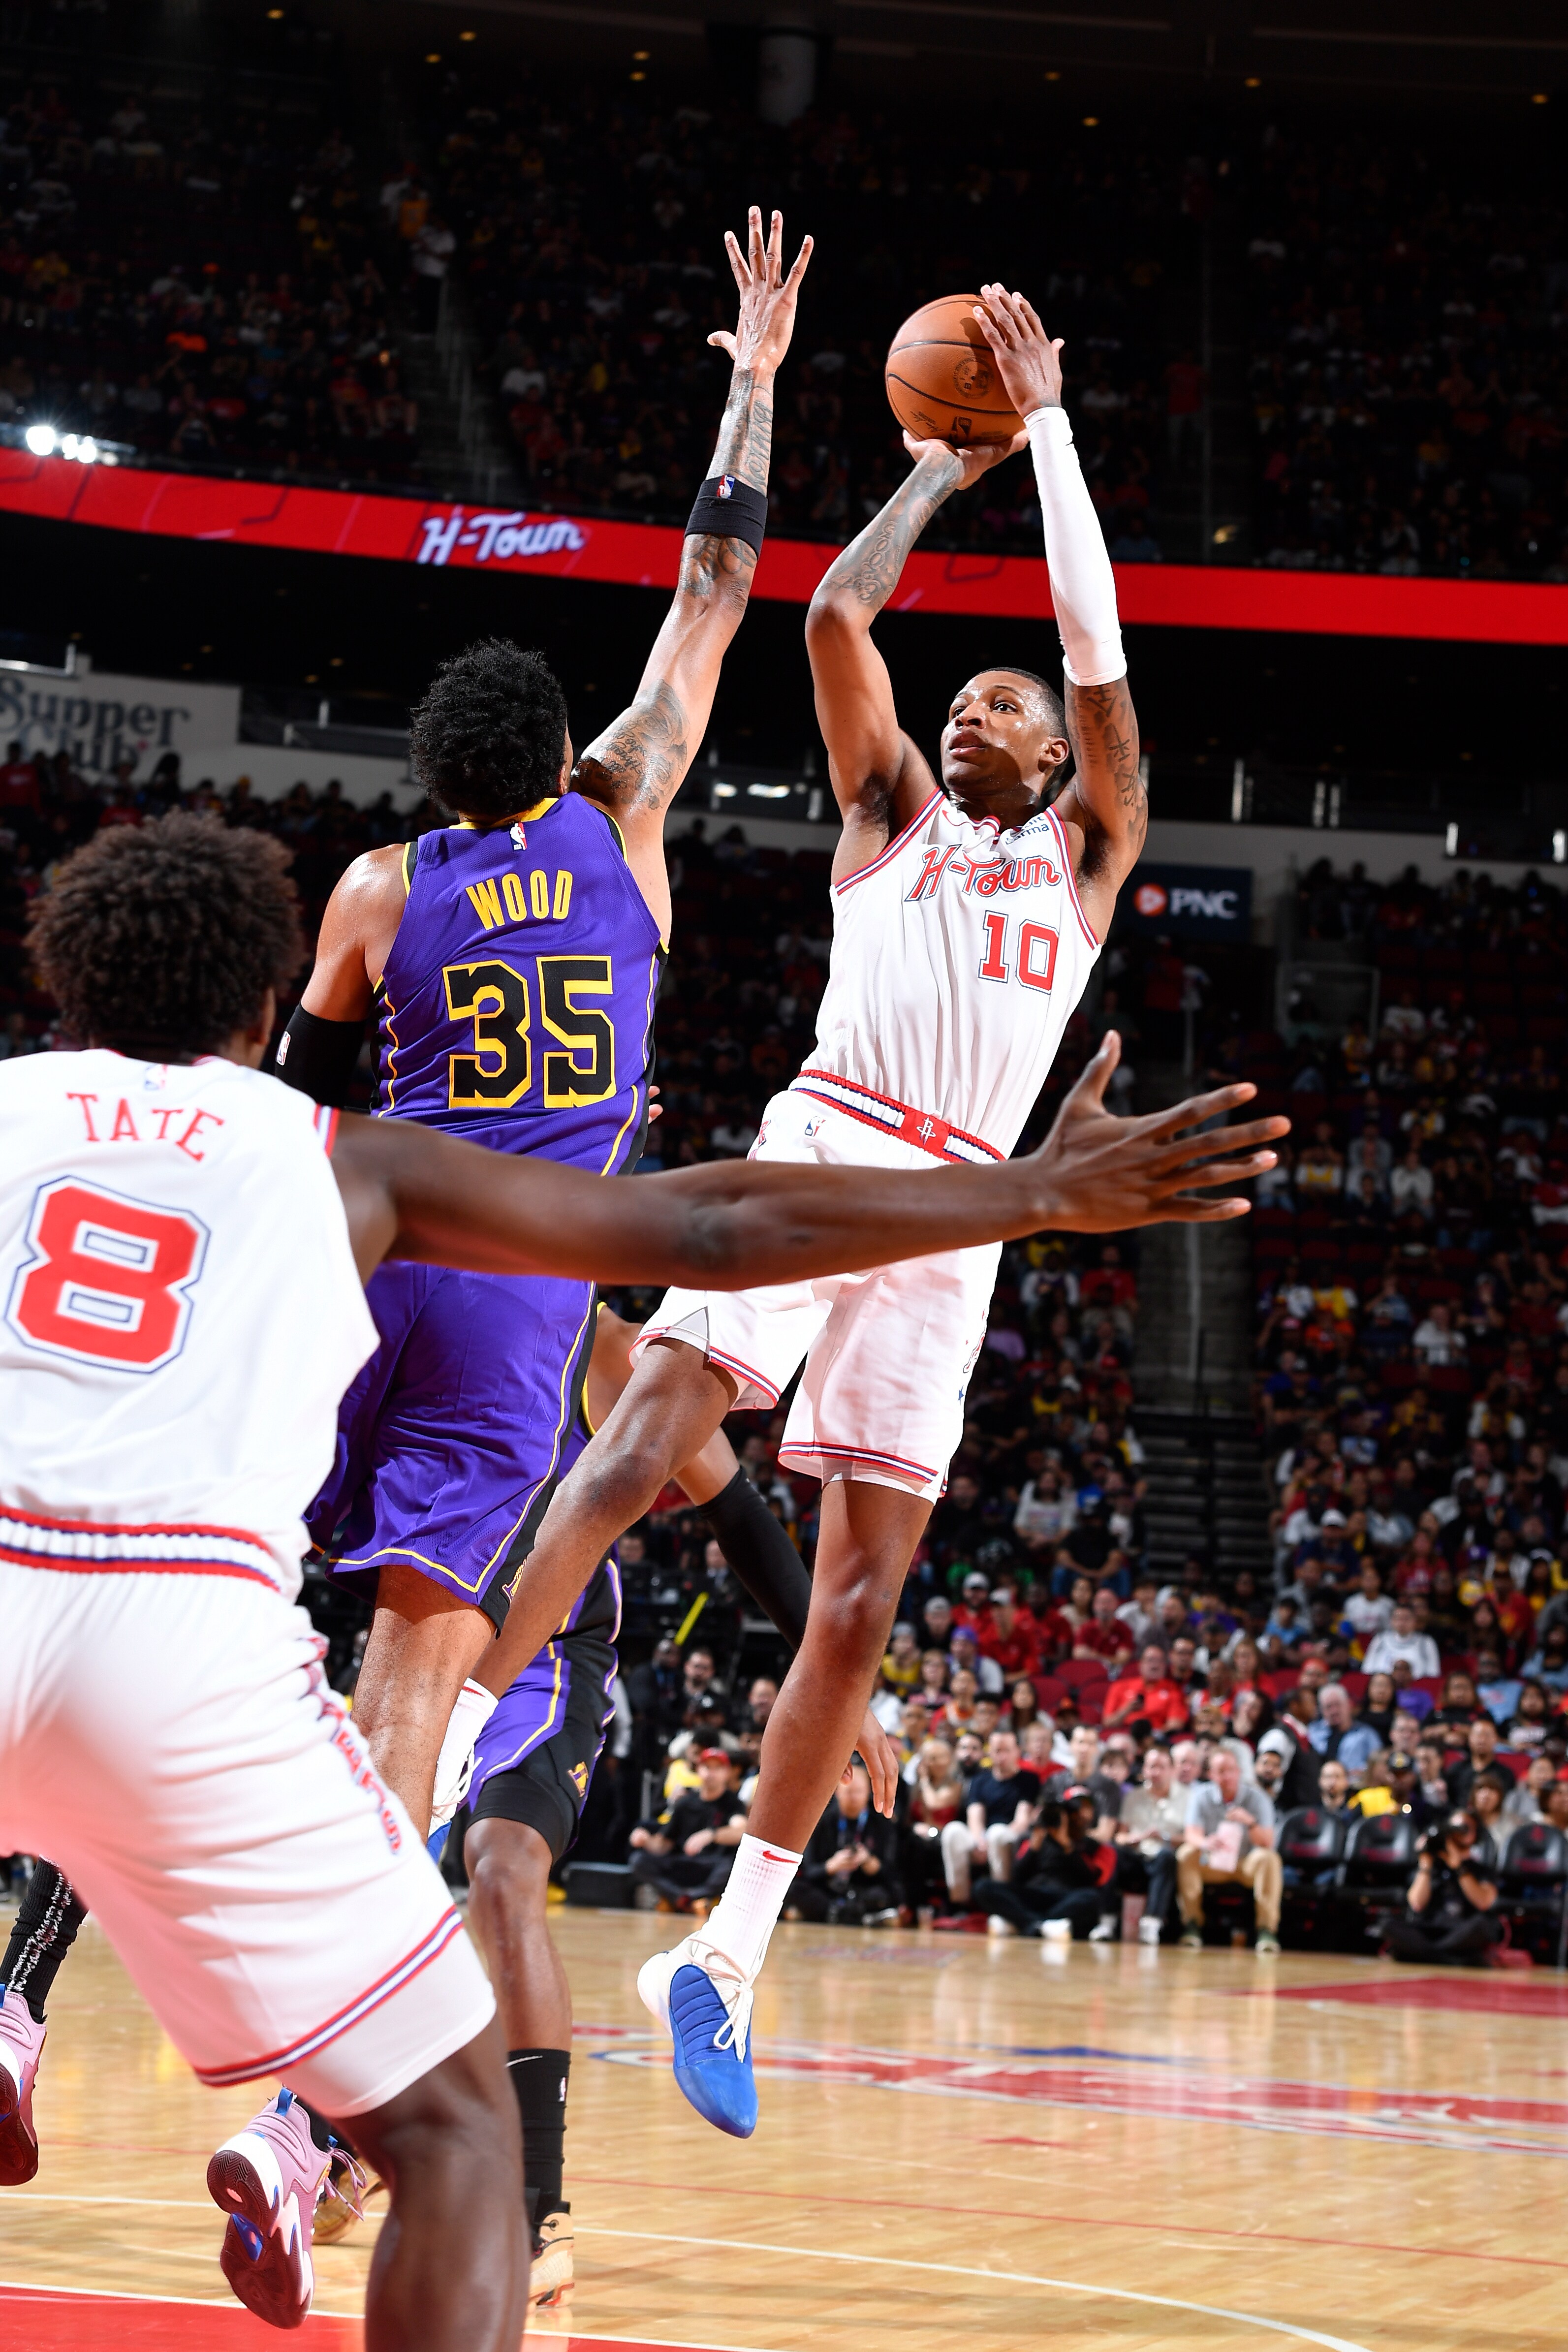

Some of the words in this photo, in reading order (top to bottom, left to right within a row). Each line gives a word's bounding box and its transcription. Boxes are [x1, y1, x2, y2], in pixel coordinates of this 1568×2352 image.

[416, 512, 584, 566] H-Town
[0, 676, 190, 747] Supper
[466, 870, 573, 930] WOOD
[904, 844, 1063, 902] H-Town
[1169, 888, 1238, 919] PNC
[978, 910, 1059, 995] 10
[443, 956, 617, 1109] 35
[66, 1092, 224, 1162] TATE
[2, 1174, 211, 1375] 8
